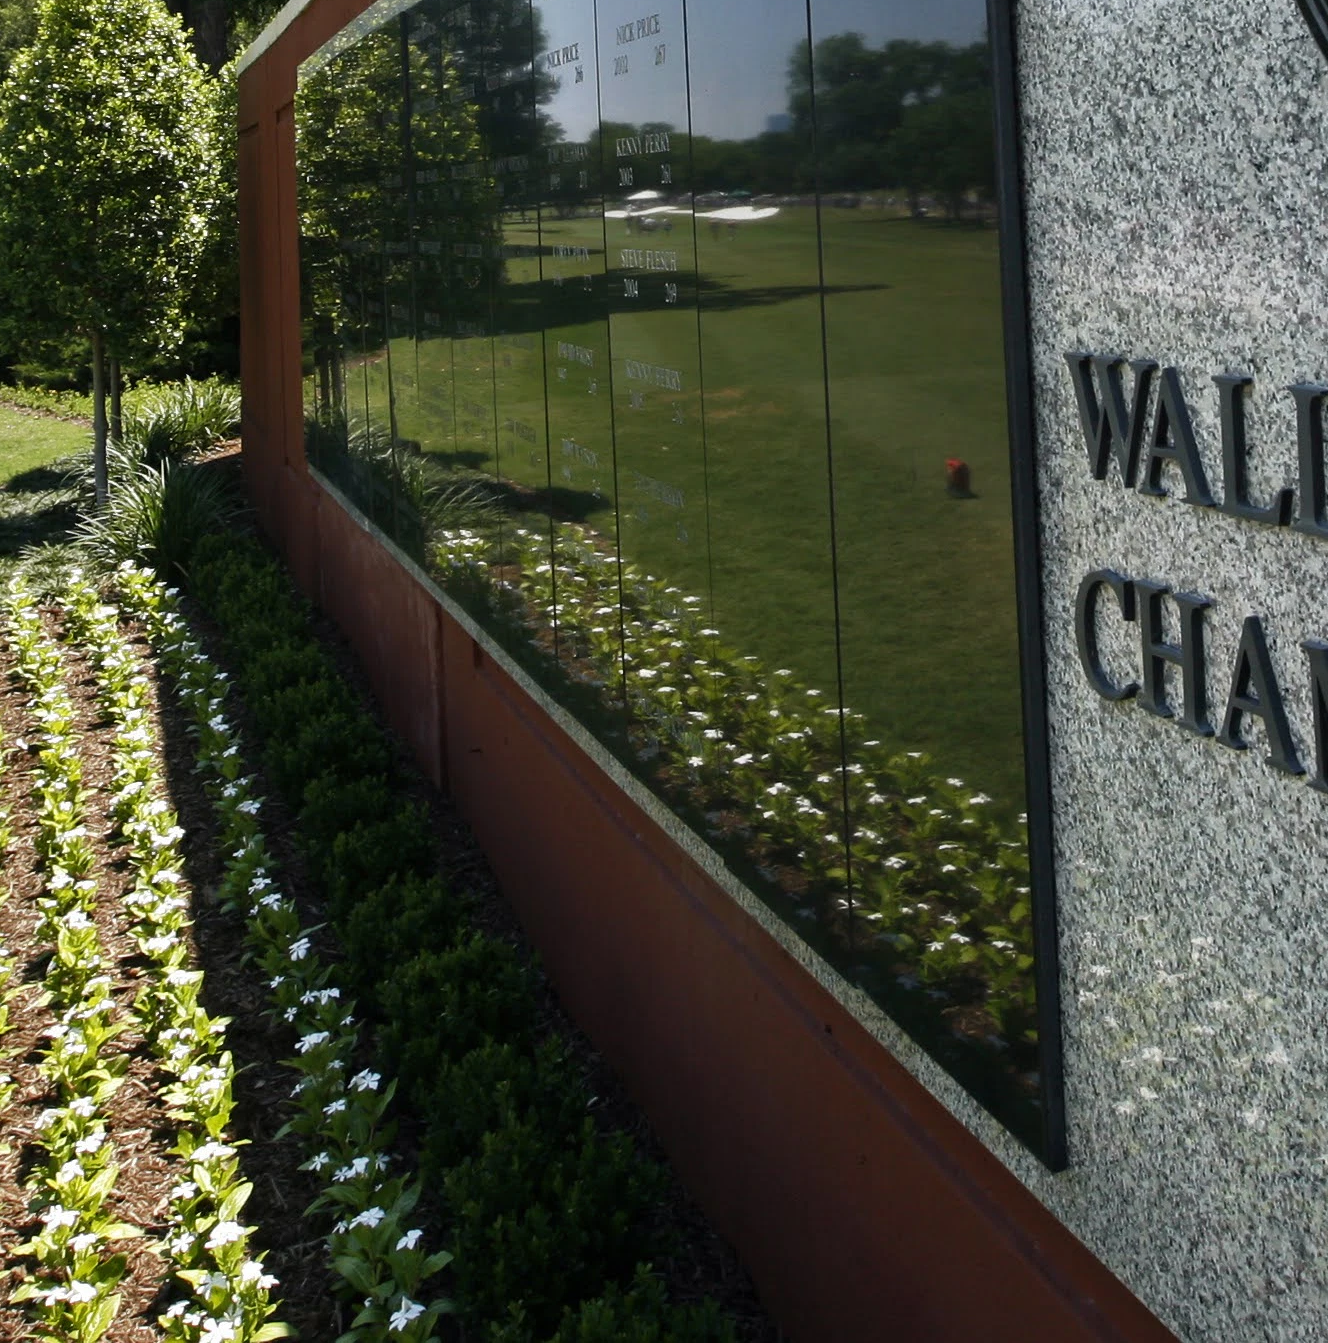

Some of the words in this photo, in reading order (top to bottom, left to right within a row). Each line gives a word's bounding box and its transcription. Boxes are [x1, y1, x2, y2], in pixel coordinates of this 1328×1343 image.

[616, 22, 635, 46] NICK
[637, 13, 661, 39] PRICE
[562, 42, 579, 64] PRICE
[616, 135, 642, 157] KENNY
[645, 132, 671, 153] PERRY
[621, 248, 644, 269] STEVE
[646, 249, 678, 272] FLESCH
